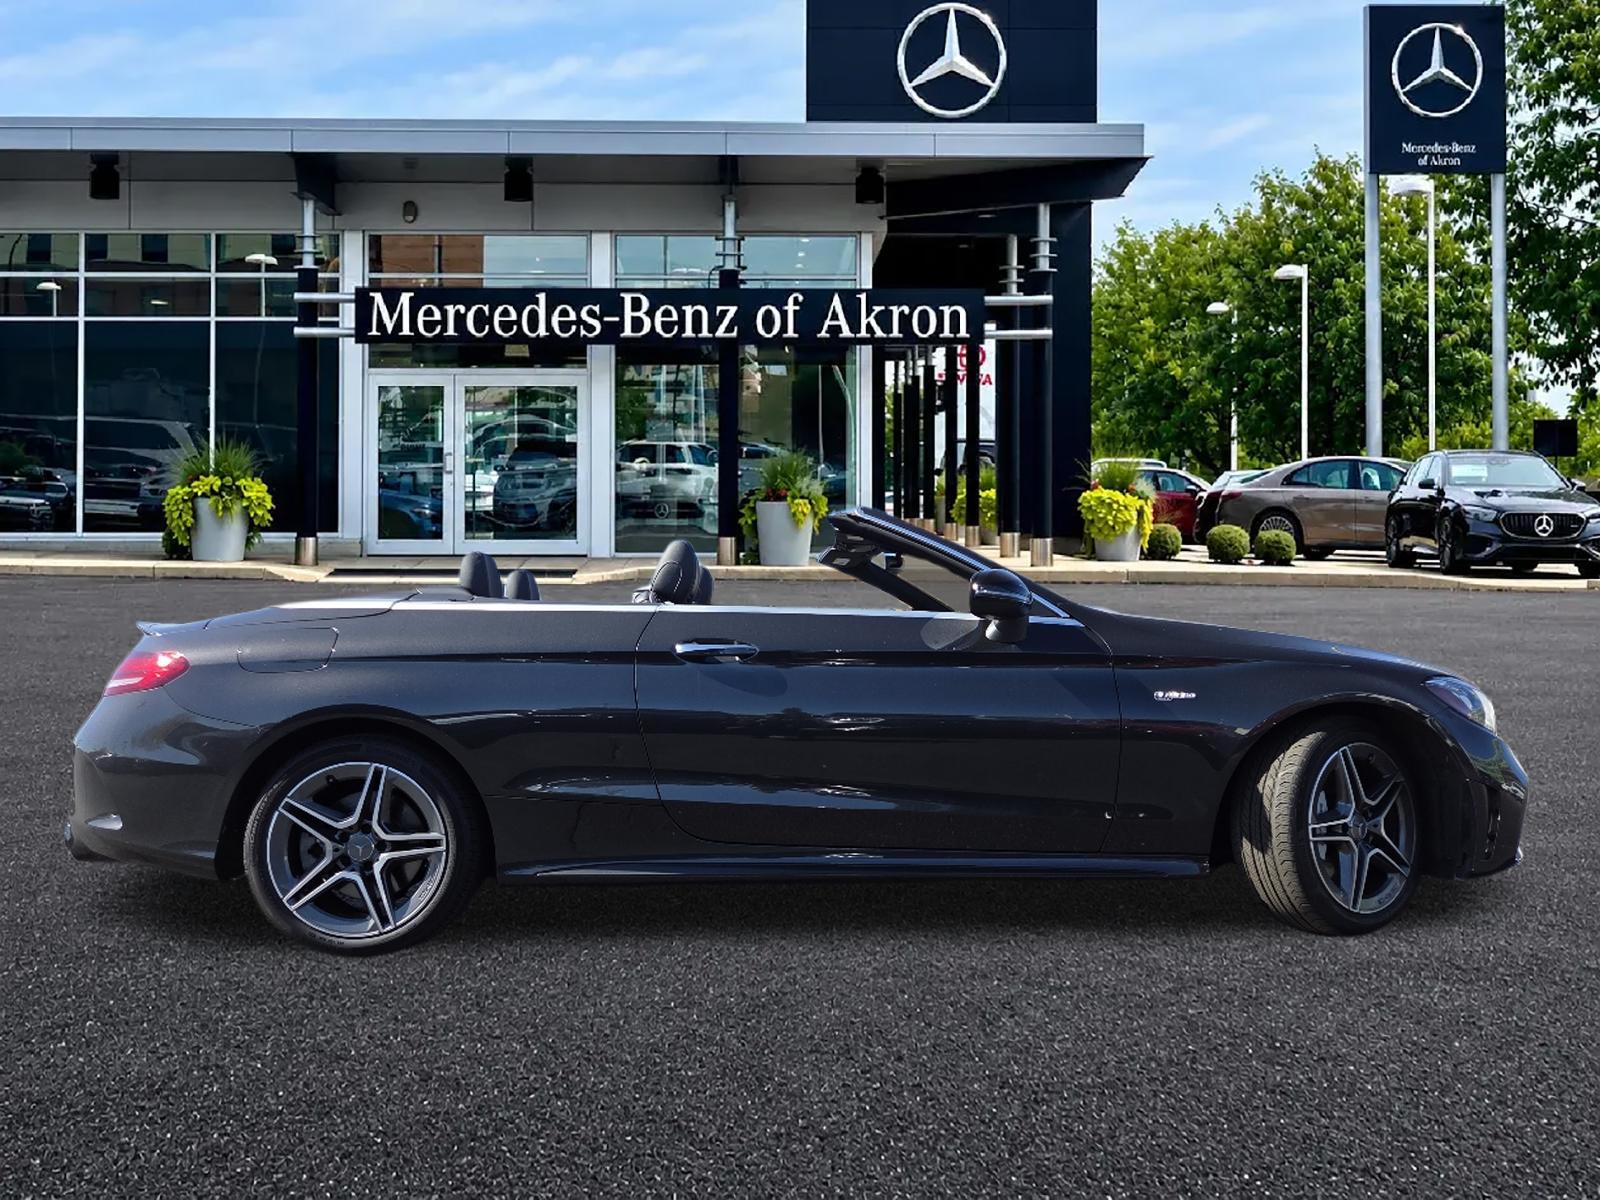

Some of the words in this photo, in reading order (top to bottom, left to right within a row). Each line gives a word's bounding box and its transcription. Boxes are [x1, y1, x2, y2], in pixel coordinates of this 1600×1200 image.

[1401, 141, 1476, 153] Mercedes-Benz
[1417, 154, 1428, 165] of
[1430, 154, 1461, 165] Akron
[367, 292, 738, 338] Mercedes-Benz
[756, 292, 804, 338] of
[816, 292, 971, 338] Akron
